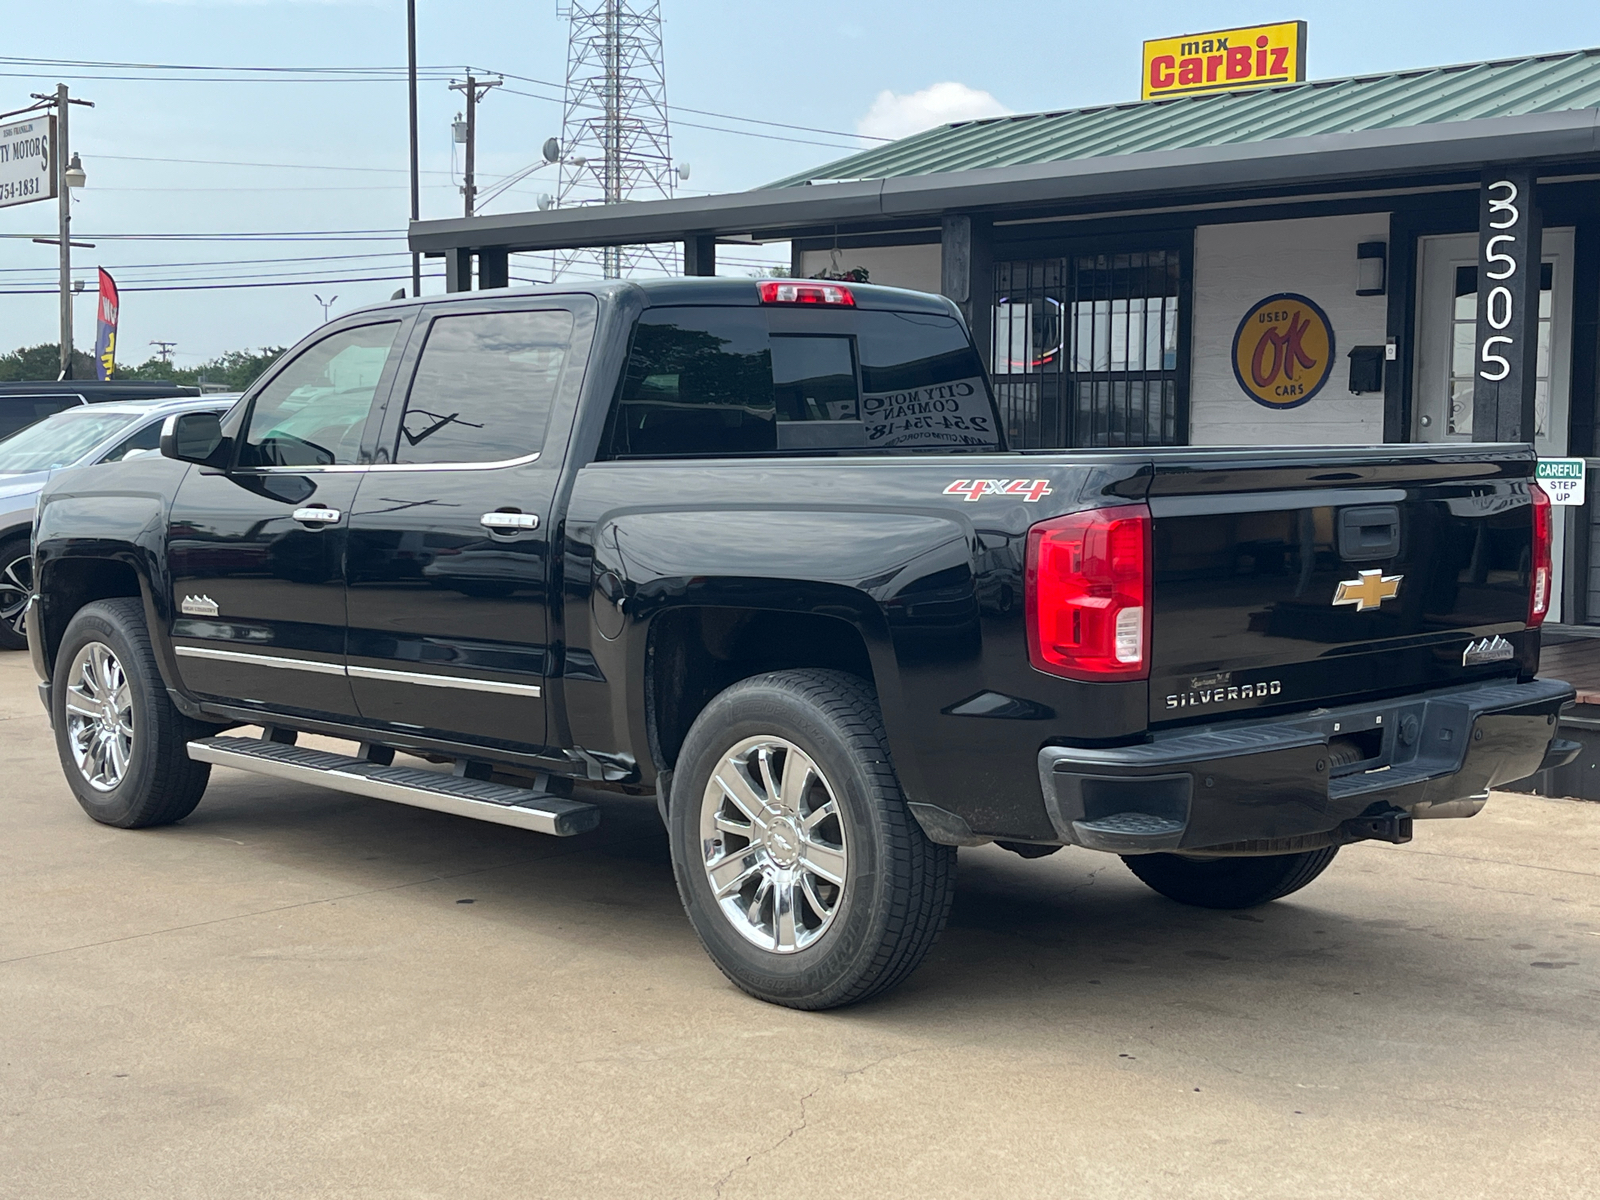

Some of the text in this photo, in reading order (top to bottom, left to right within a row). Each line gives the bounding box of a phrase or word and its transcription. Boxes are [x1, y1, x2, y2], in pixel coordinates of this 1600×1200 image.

[1181, 38, 1229, 56] max
[1150, 35, 1289, 88] CarBiz
[13, 135, 48, 171] MOTORS
[1480, 180, 1519, 381] 3505
[1259, 311, 1288, 323] USED
[1251, 310, 1317, 388] OK
[1275, 384, 1304, 396] CARS
[1538, 464, 1581, 476] CAREFUL
[1550, 481, 1577, 490] STEP
[1556, 493, 1570, 501] UP
[1166, 680, 1281, 709] SILVERADO
